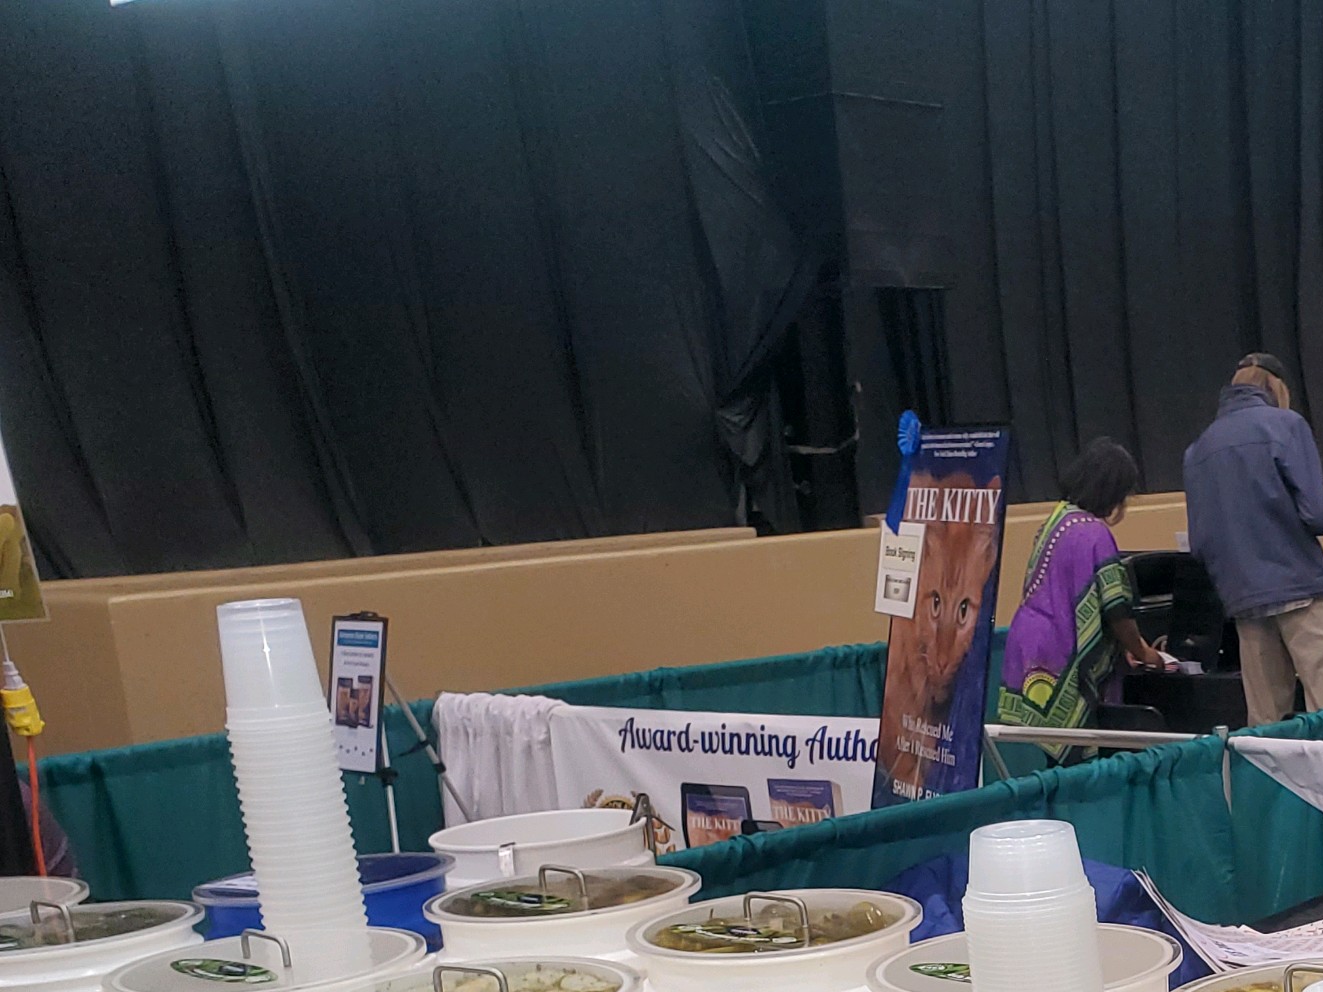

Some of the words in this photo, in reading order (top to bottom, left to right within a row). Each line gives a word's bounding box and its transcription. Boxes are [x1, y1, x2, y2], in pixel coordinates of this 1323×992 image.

[906, 487, 939, 521] THE
[940, 488, 1001, 524] KITTY
[618, 717, 800, 769] Award-winning
[942, 724, 954, 741] Me
[941, 747, 957, 766] Him
